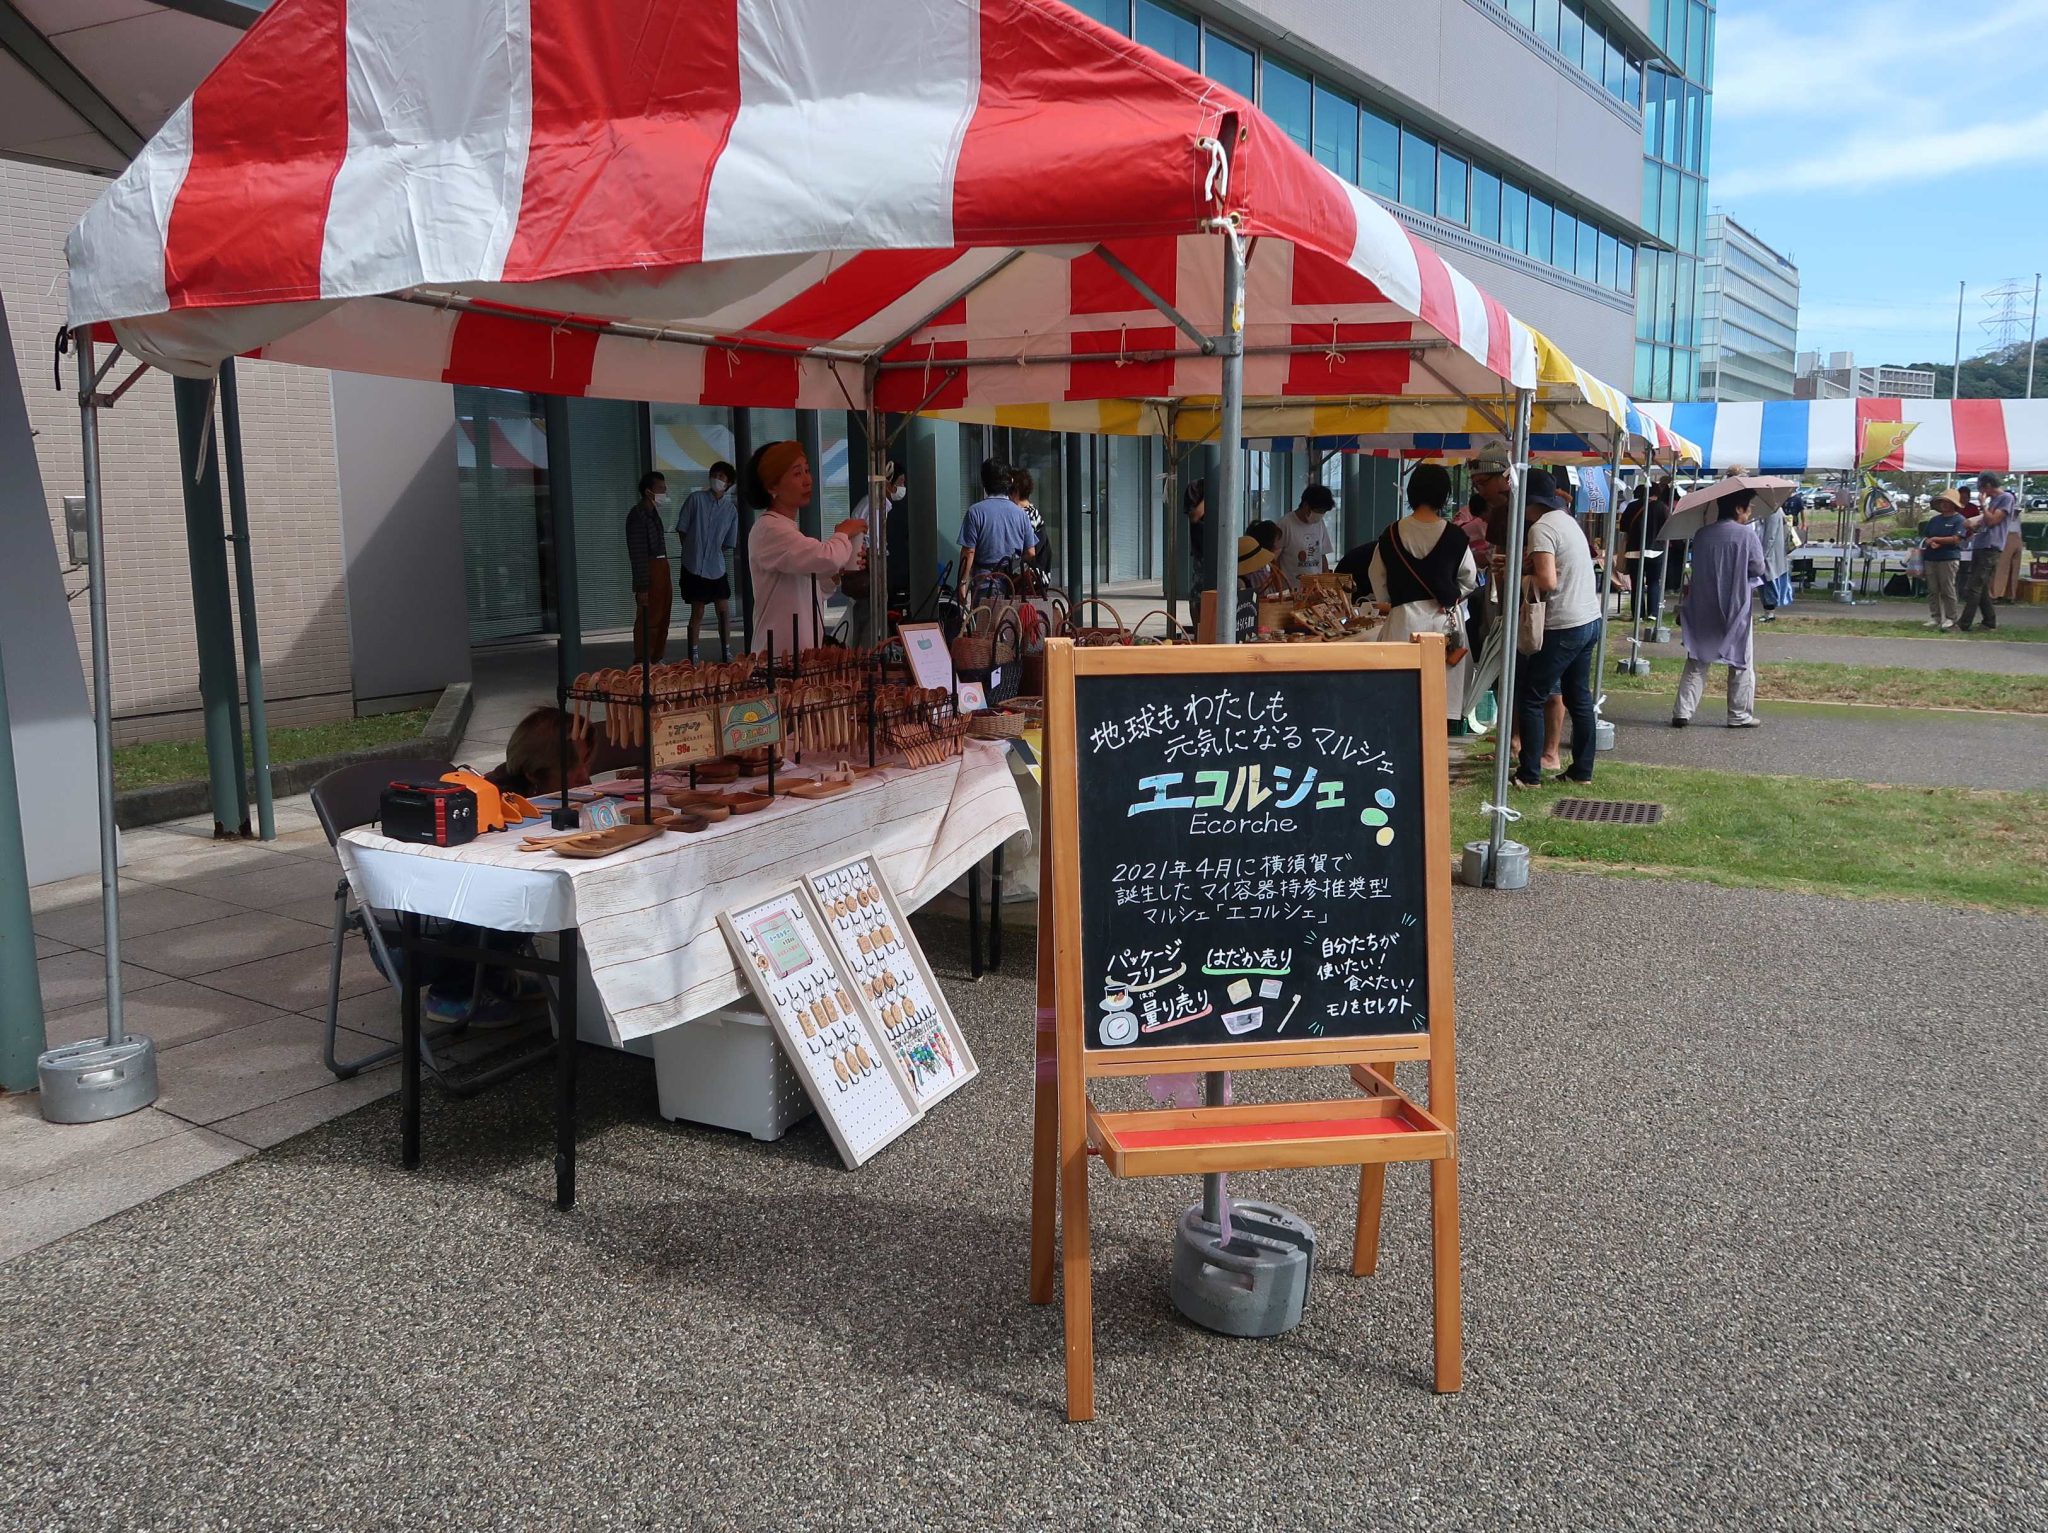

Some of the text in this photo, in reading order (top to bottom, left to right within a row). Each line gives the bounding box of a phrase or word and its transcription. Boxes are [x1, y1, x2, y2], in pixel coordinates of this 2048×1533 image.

[1090, 688, 1288, 753] 地球もわたしも
[1165, 725, 1395, 774] 元気になるマルシェ
[1127, 764, 1346, 818] エコルシェ
[1189, 812, 1298, 835] Ecorche
[1111, 852, 1353, 882] 2021年4月に横須賀で
[1143, 902, 1328, 924] マルシェ「エコルシェ」
[1107, 938, 1183, 972] パッケージ
[1206, 947, 1292, 969] はだか売り
[1321, 931, 1400, 959] 自分たちが
[1127, 966, 1173, 986] フリー
[1316, 953, 1386, 981] 使いたい！
[1344, 974, 1415, 993] 食べたい！
[1140, 989, 1208, 1029] 量り売り
[1326, 995, 1412, 1017] モノをセレクト
